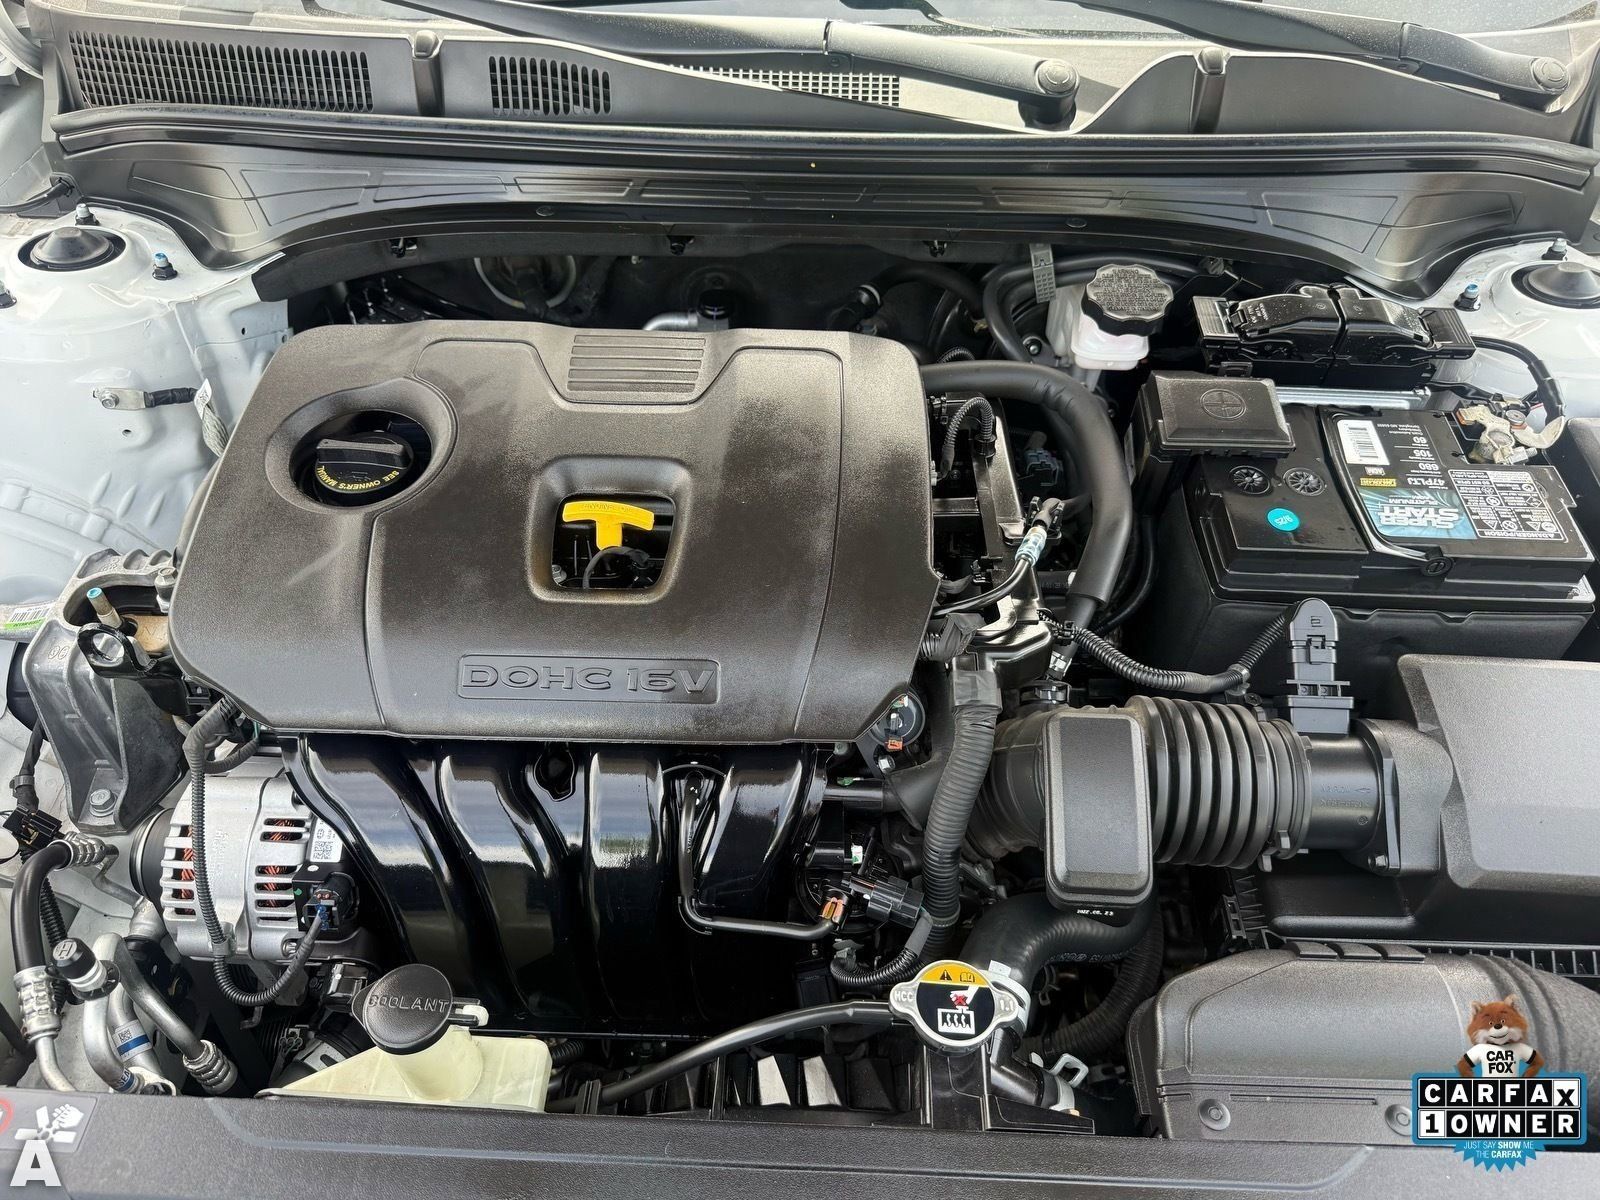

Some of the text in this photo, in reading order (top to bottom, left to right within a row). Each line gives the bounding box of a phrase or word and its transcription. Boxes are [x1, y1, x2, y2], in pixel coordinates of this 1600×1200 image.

[1412, 436, 1427, 444] 60
[1413, 449, 1433, 457] 105
[1418, 462, 1439, 471] 680
[316, 465, 400, 490] SEE OWNER'S MANUAL
[1407, 477, 1445, 486] 47PLTJ
[1377, 506, 1459, 520] START
[1380, 516, 1455, 529] SUPER
[462, 664, 715, 694] DOHC 16V
[58, 942, 73, 957] H
[894, 990, 914, 1002] HCC
[367, 994, 449, 1013] COOLANT
